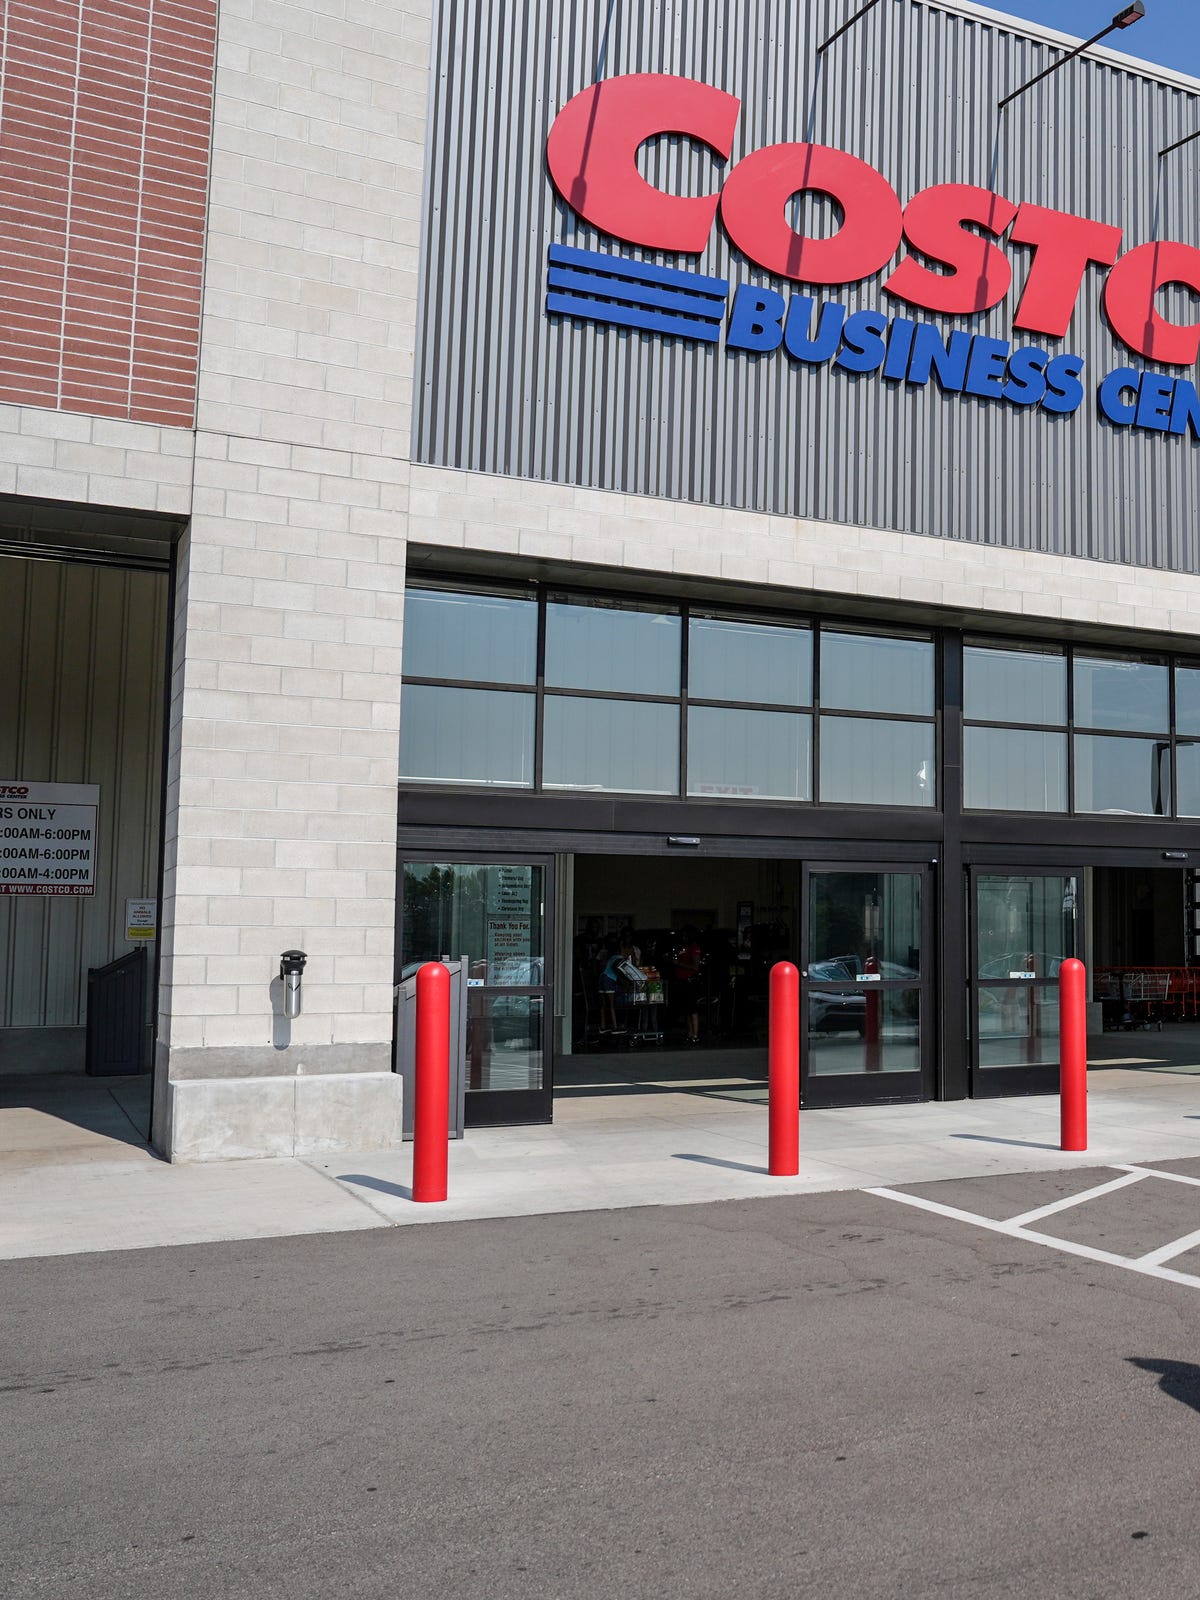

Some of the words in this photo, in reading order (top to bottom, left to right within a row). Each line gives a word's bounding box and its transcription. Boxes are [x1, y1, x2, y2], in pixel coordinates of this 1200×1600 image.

[726, 284, 1084, 415] BUSINESS
[0, 785, 29, 795] TCO
[17, 807, 57, 820] ONLY
[0, 867, 89, 880] 00AM-4:00PM
[9, 885, 93, 894] WWW.COSTCO.COM
[490, 922, 506, 930] Thank
[508, 922, 519, 930] You
